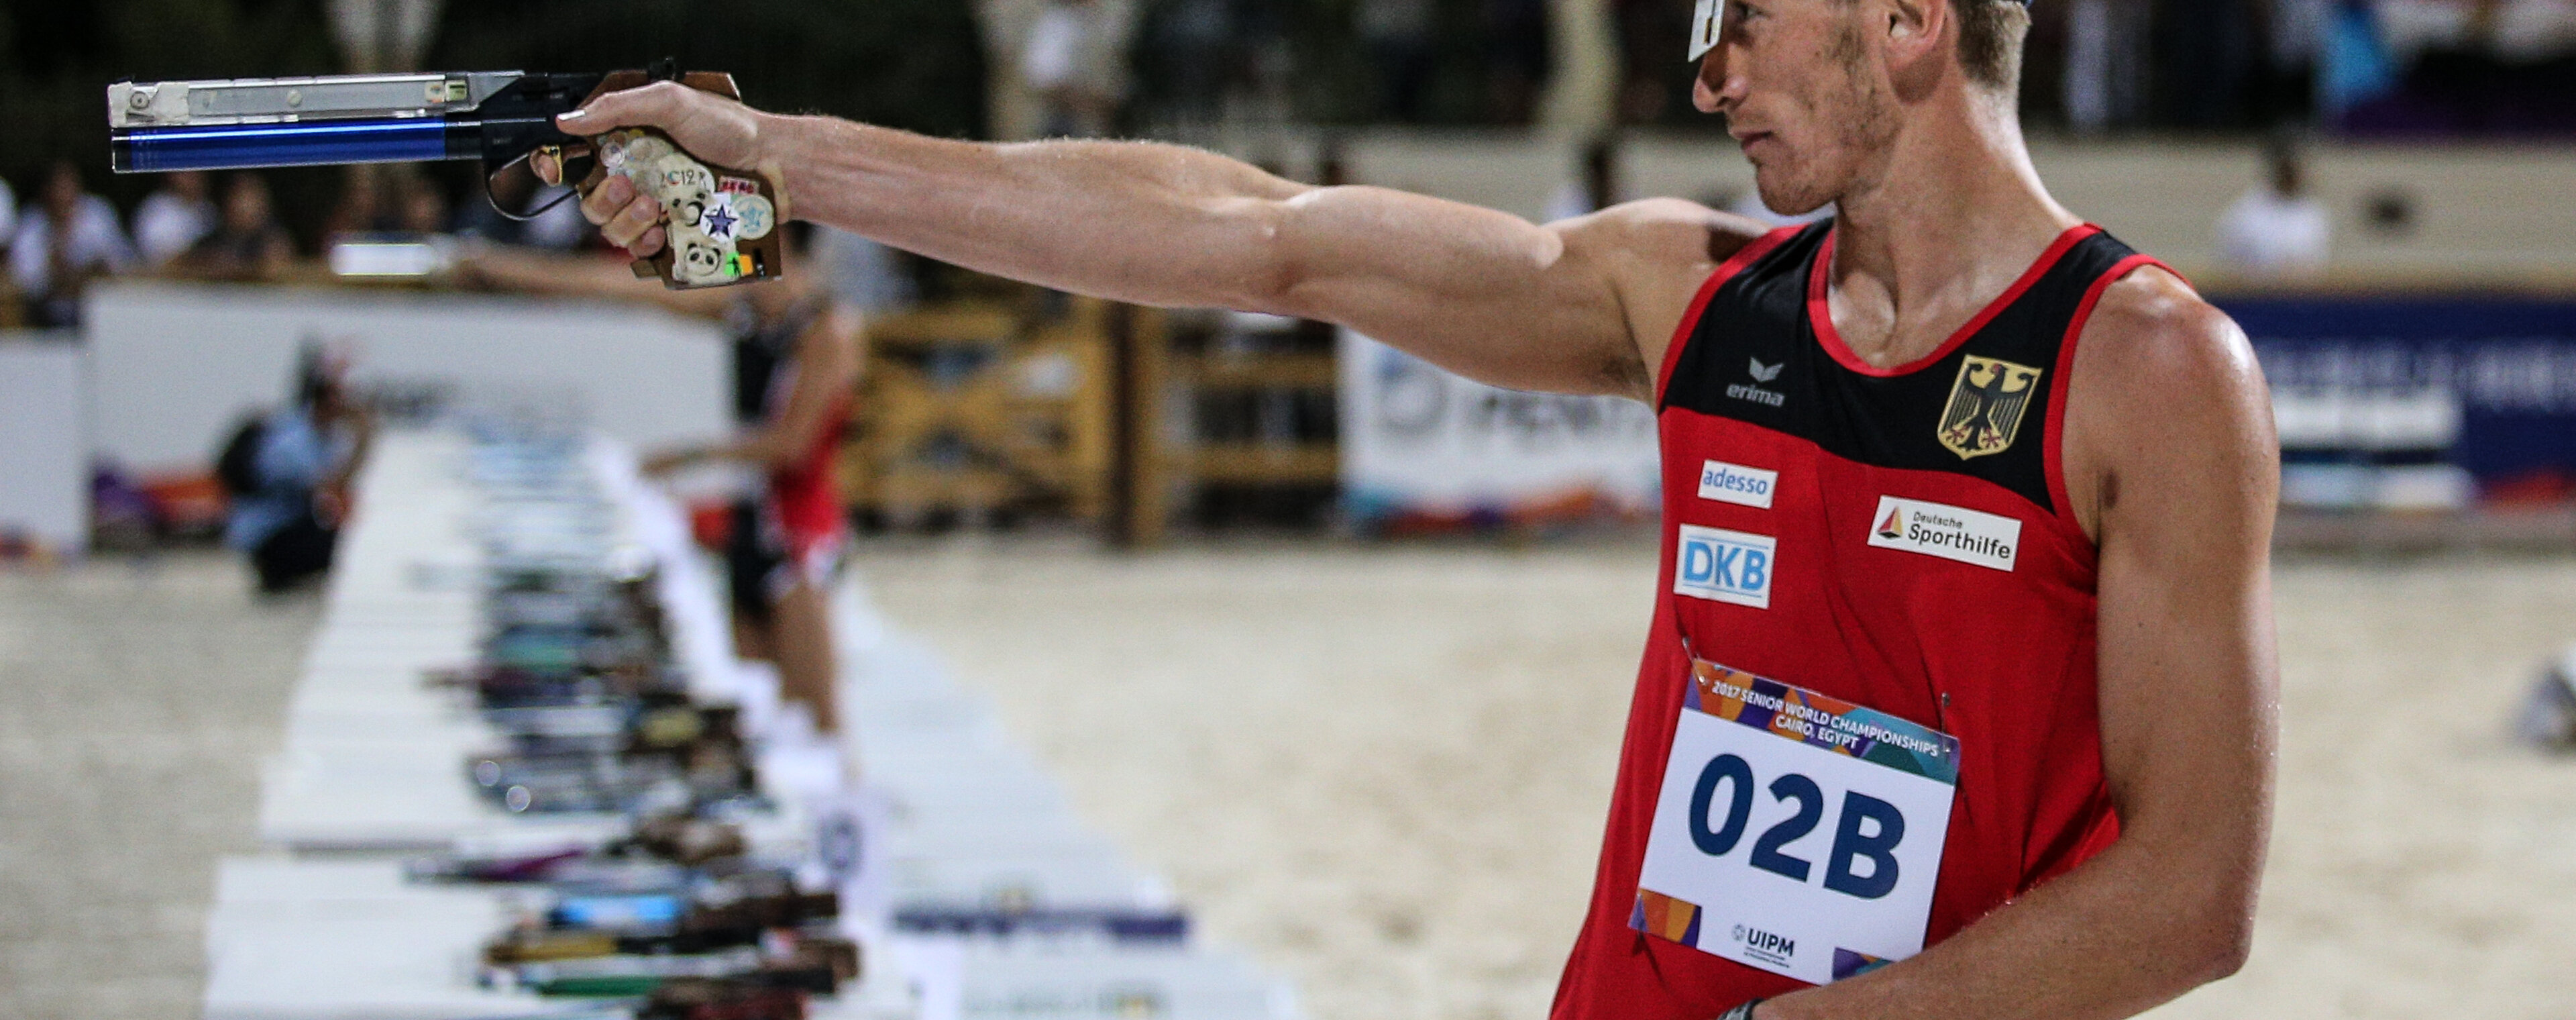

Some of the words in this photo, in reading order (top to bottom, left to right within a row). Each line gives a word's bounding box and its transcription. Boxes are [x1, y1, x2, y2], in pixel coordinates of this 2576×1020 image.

[1727, 384, 1785, 407] erima
[1703, 468, 1768, 495] adesso
[1913, 511, 1963, 529] Deutsche
[1909, 523, 2010, 559] Sporthilfe
[1683, 541, 1766, 591] DKB
[1712, 680, 1741, 699] 2017
[1740, 689, 1784, 712] SENIOR
[1784, 702, 1829, 725] WORLD
[1830, 715, 1939, 758] CHAMPIONSHIPS
[1817, 727, 1860, 750] EGYPT
[1688, 753, 1905, 900] 02B
[1748, 927, 1794, 958] UIPM
